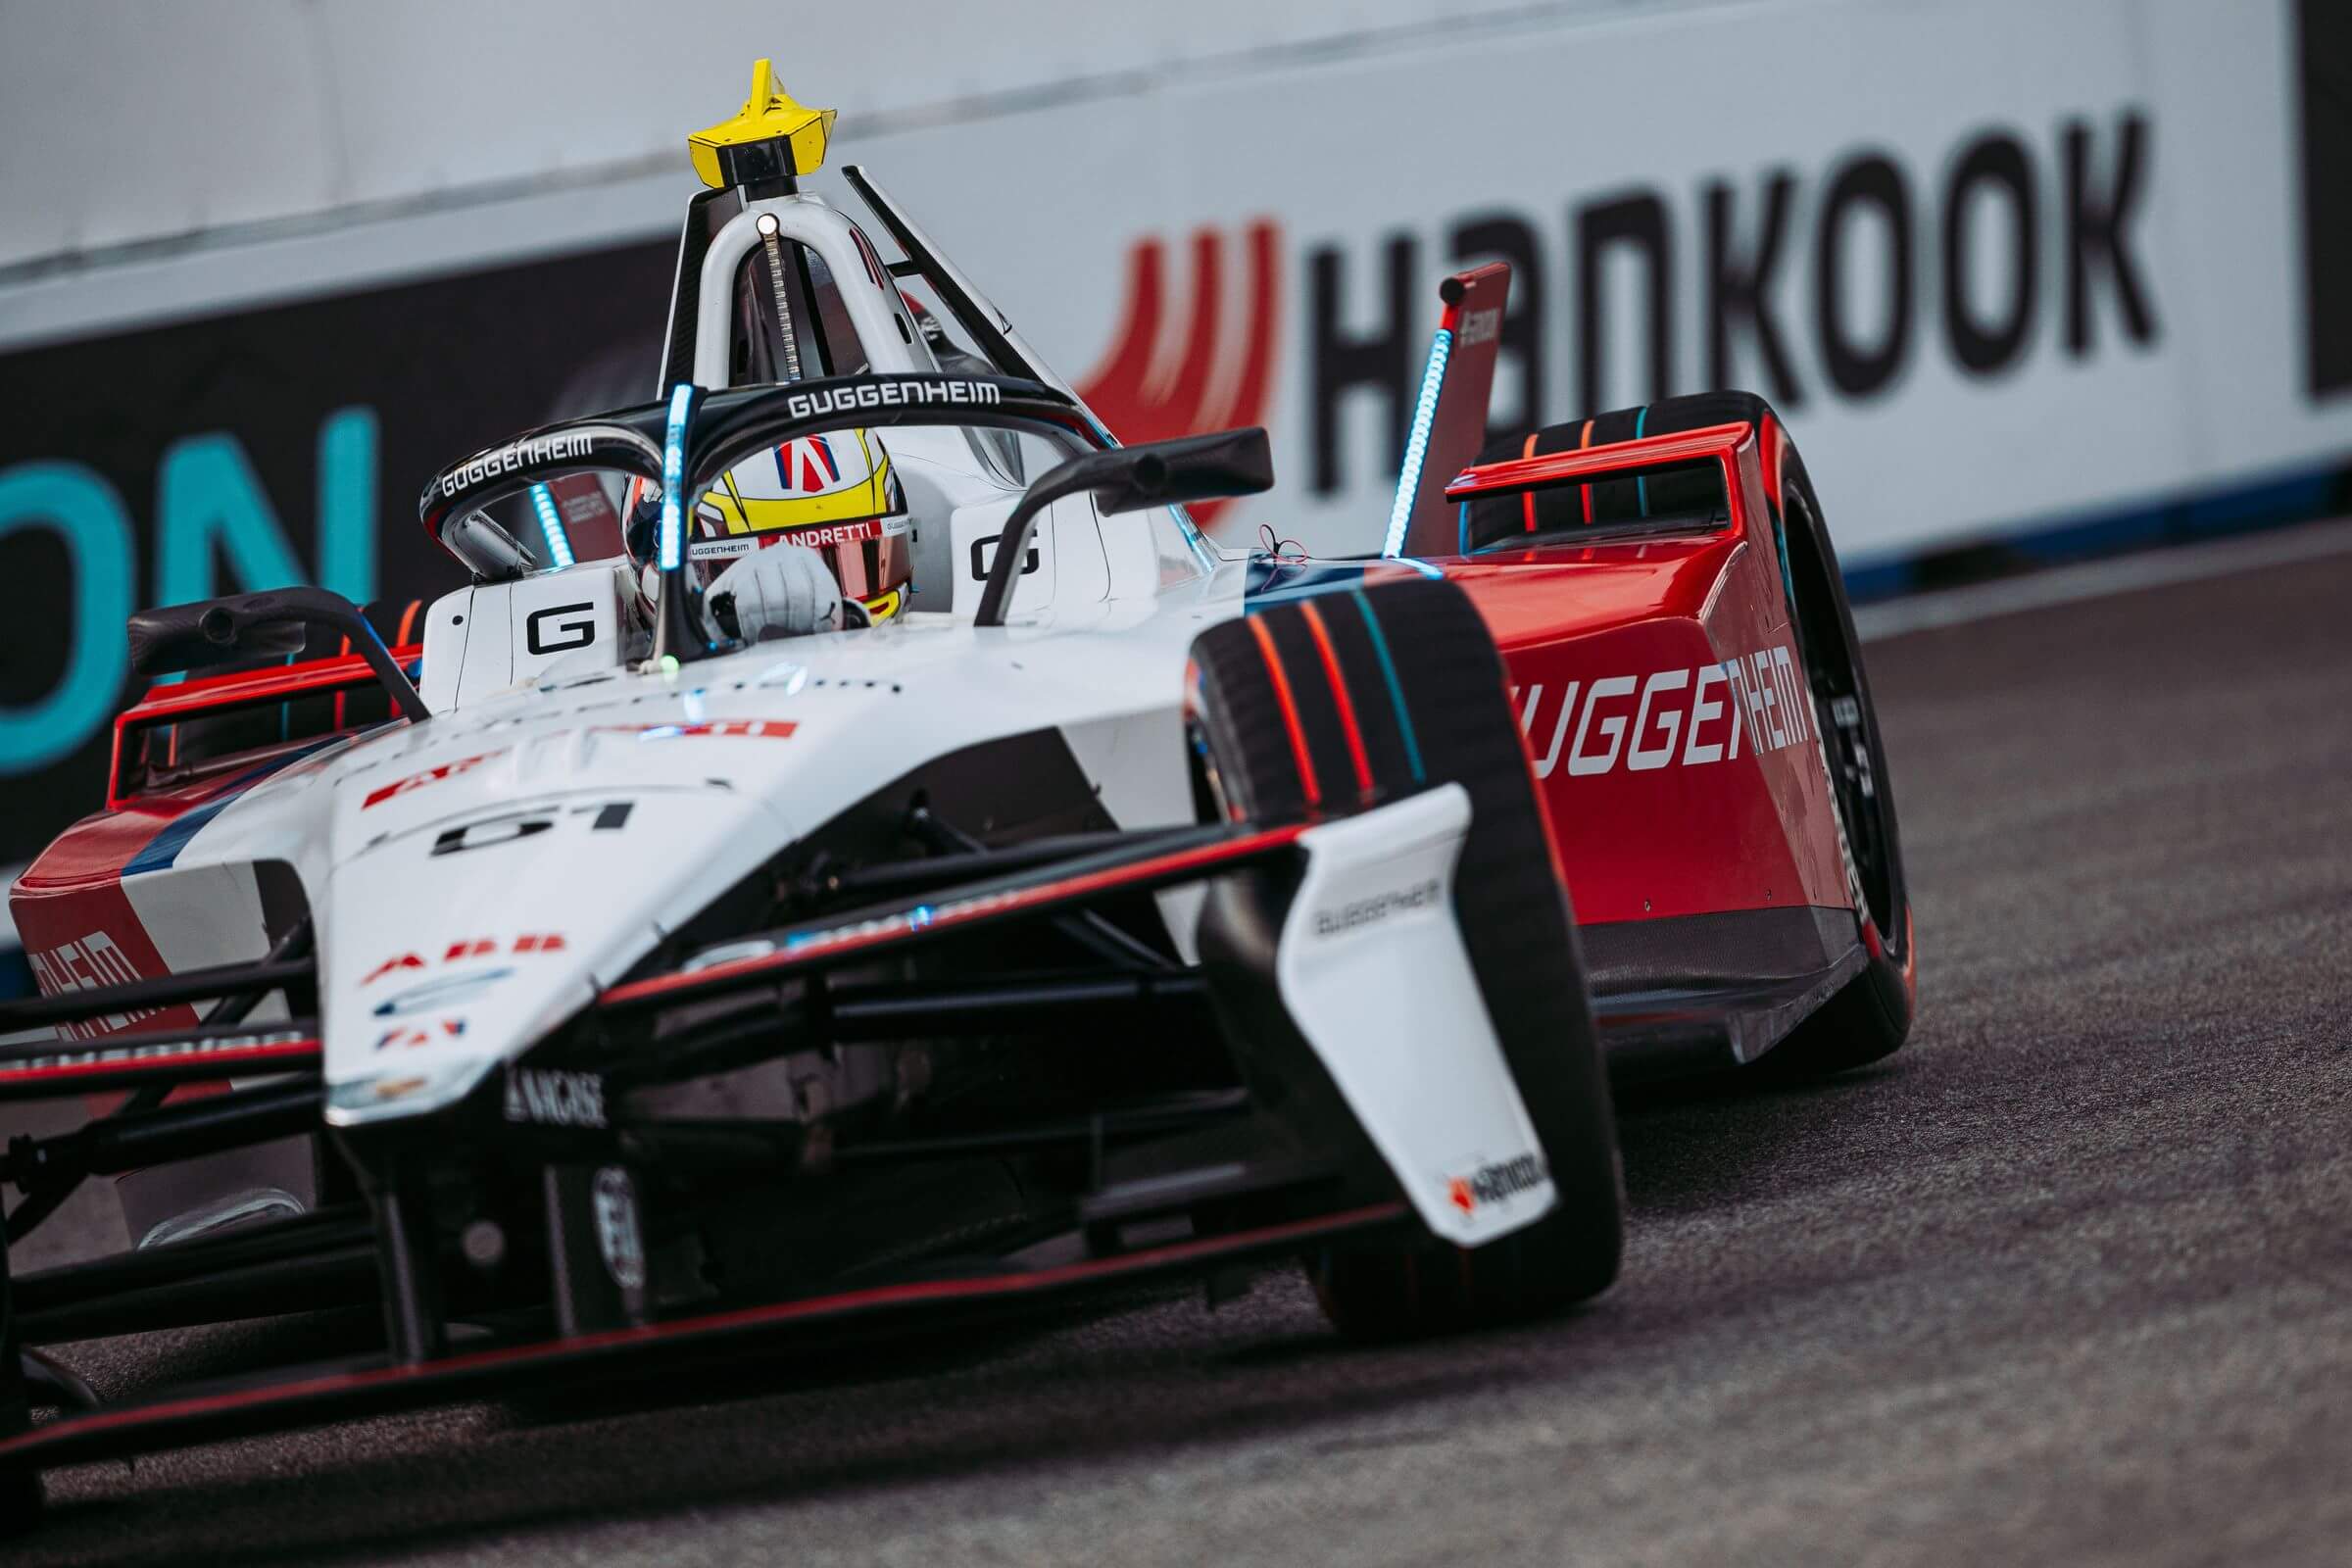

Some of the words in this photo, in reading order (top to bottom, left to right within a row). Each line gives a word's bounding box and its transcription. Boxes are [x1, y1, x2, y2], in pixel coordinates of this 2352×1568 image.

[787, 381, 1001, 418] GUGGENHEIM
[442, 432, 593, 497] GUGGENHEIM
[690, 543, 751, 556] UGGENHEIM
[776, 522, 871, 548] ANDRETTI
[526, 602, 596, 656] G
[1510, 646, 1809, 779] UGGENHEIM
